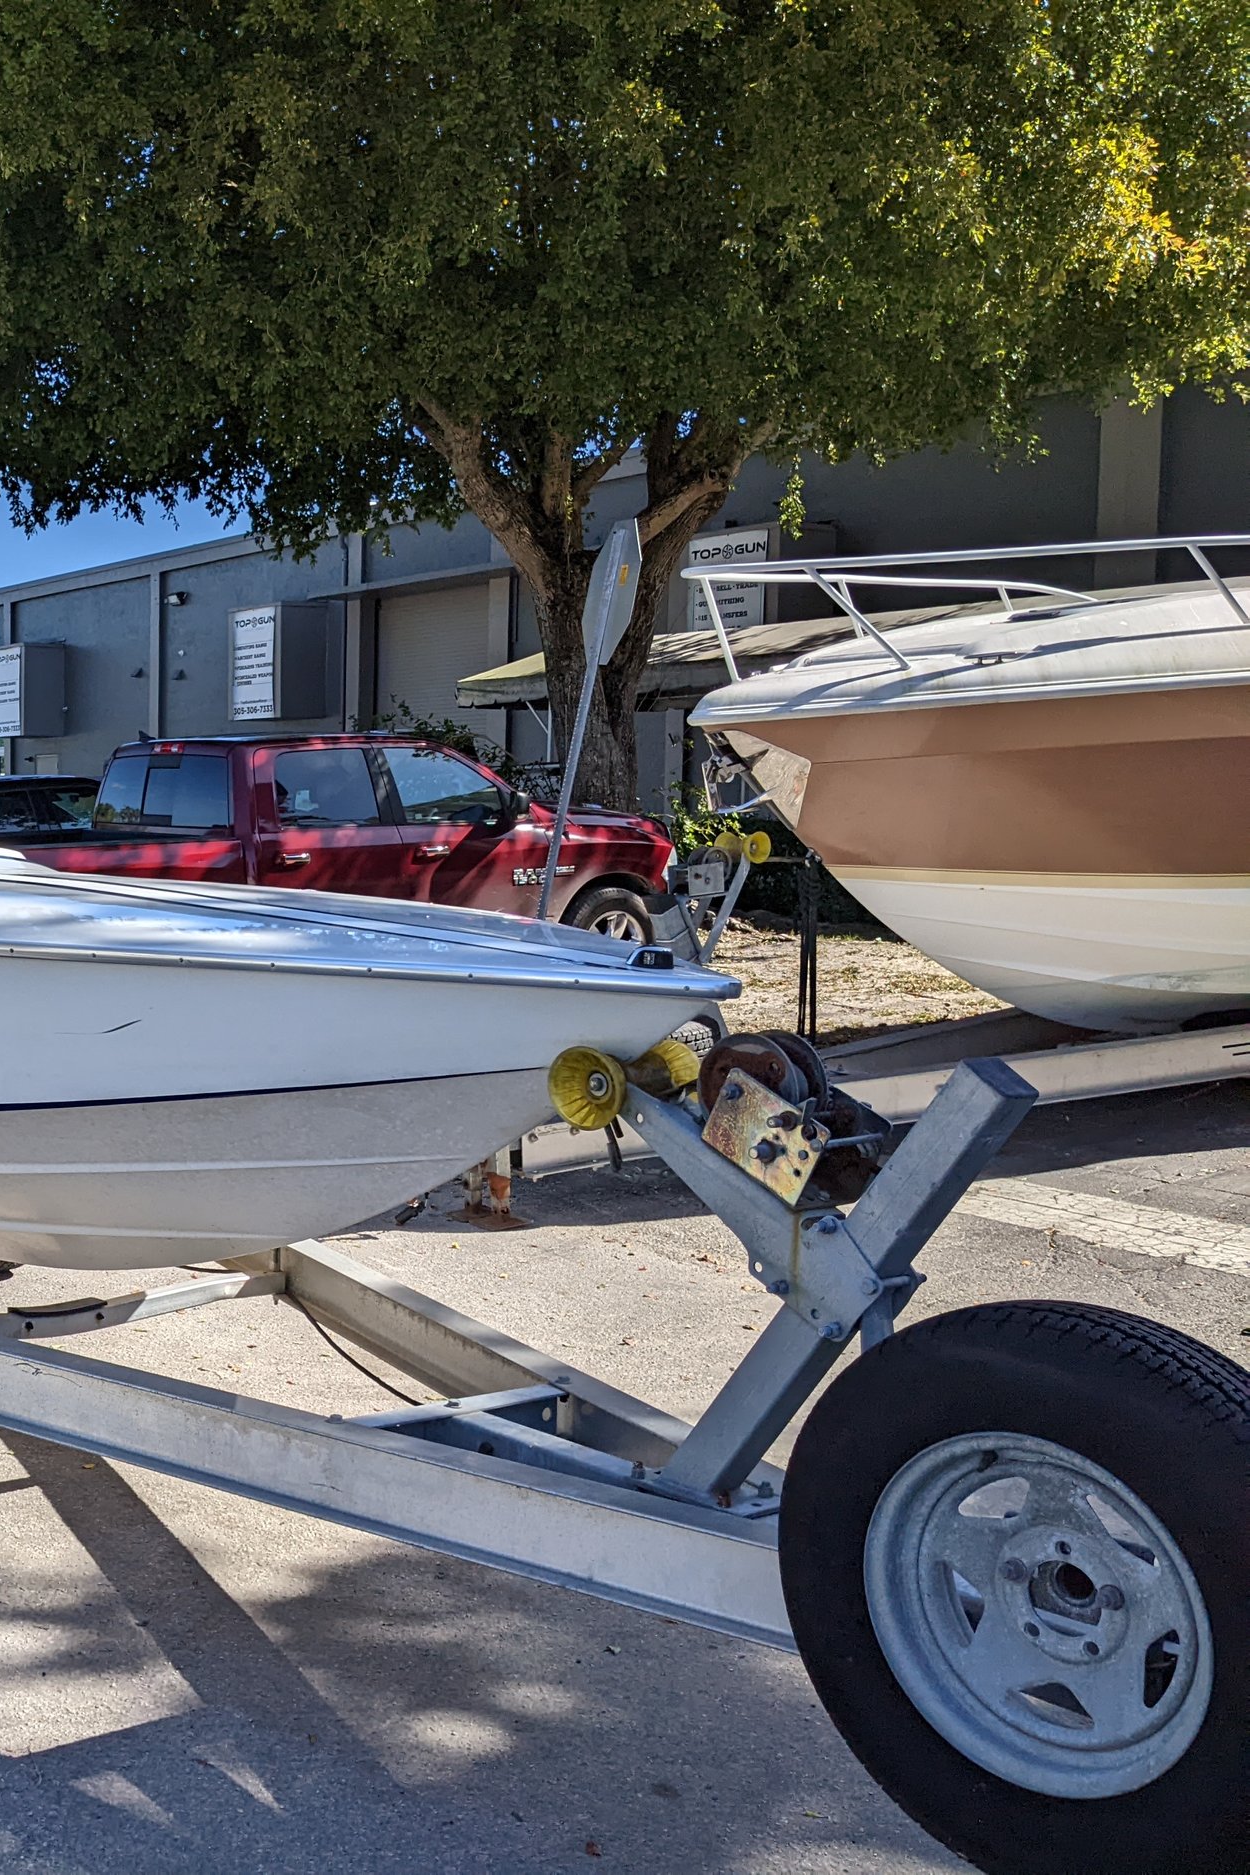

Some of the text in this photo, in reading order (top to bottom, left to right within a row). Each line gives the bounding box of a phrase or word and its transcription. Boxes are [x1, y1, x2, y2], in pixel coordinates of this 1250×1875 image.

[692, 541, 766, 560] TOP GUN
[235, 615, 275, 628] TOP GUN
[233, 705, 273, 715] 305-306-7333
